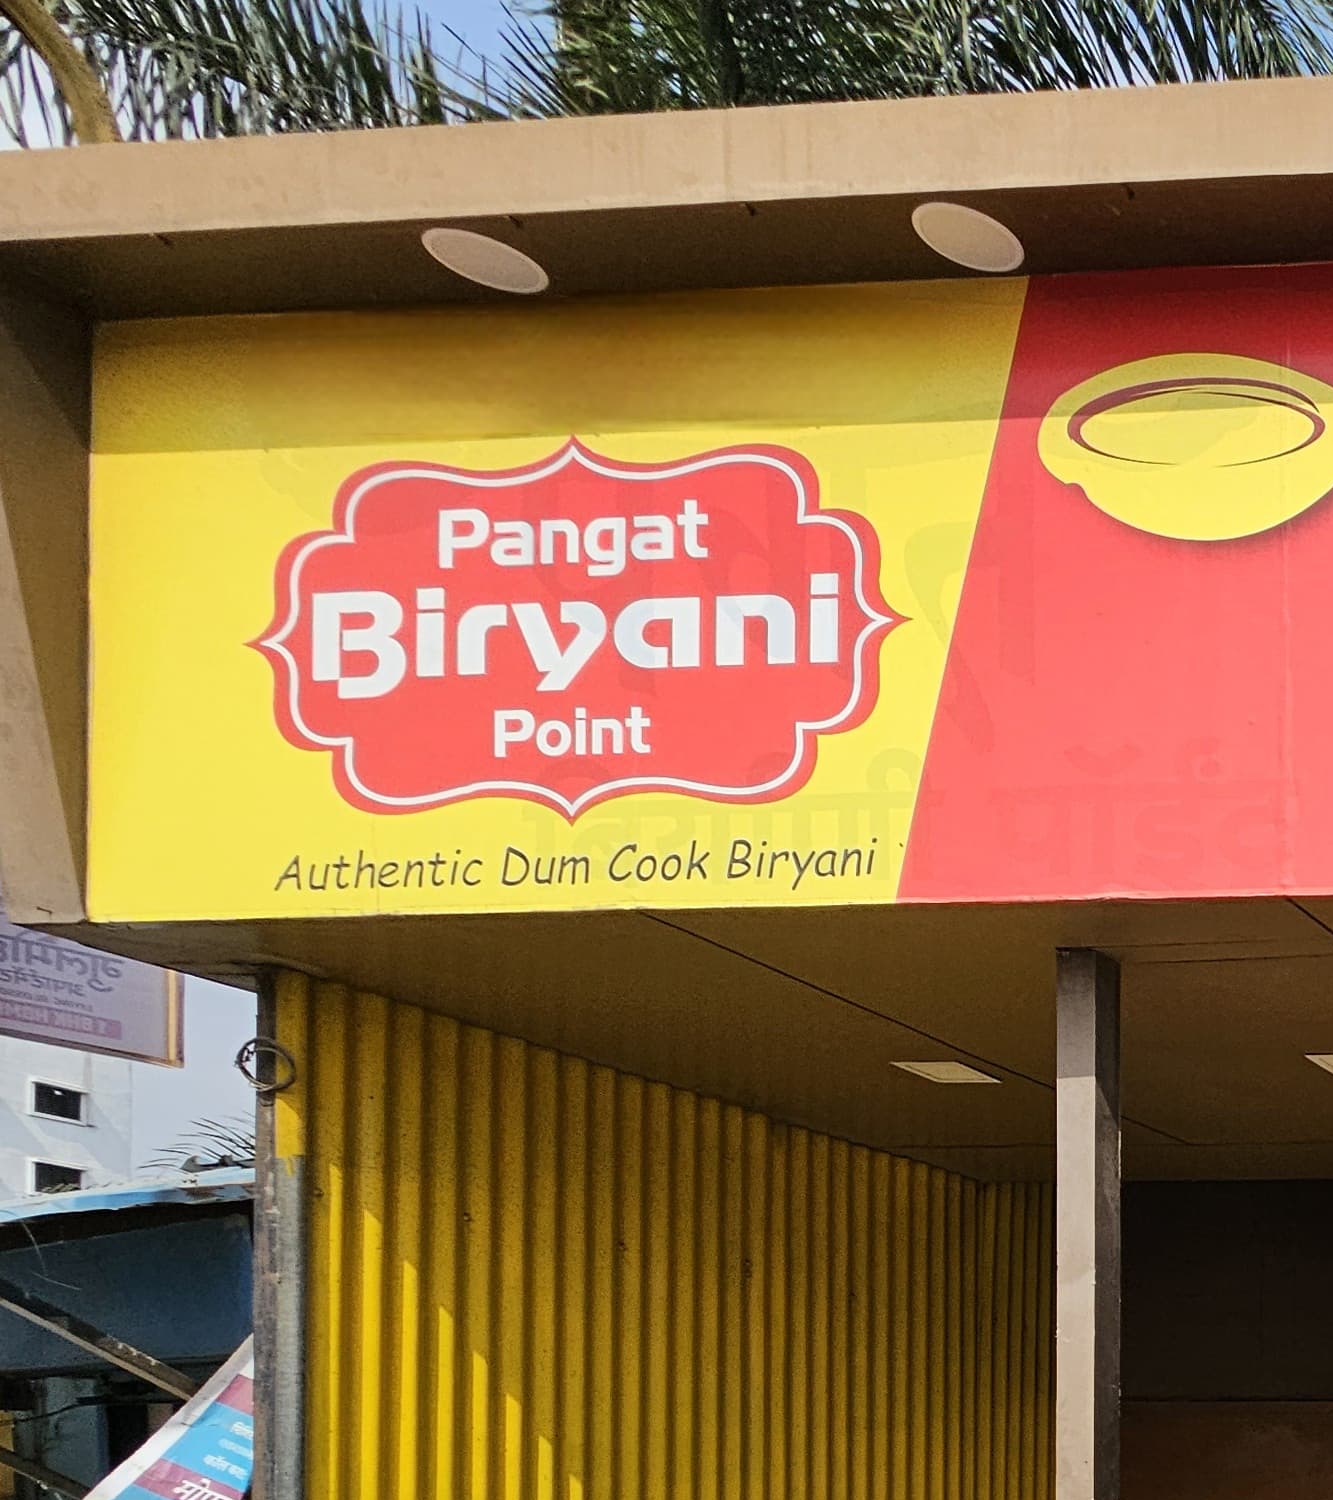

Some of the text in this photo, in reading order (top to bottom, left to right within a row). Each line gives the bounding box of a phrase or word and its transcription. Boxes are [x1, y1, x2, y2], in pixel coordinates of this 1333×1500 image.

[438, 500, 709, 577] Pangat
[312, 573, 840, 700] Biryani
[493, 706, 651, 758] Point
[274, 838, 878, 892] Authentic Dum Cook Biryani
